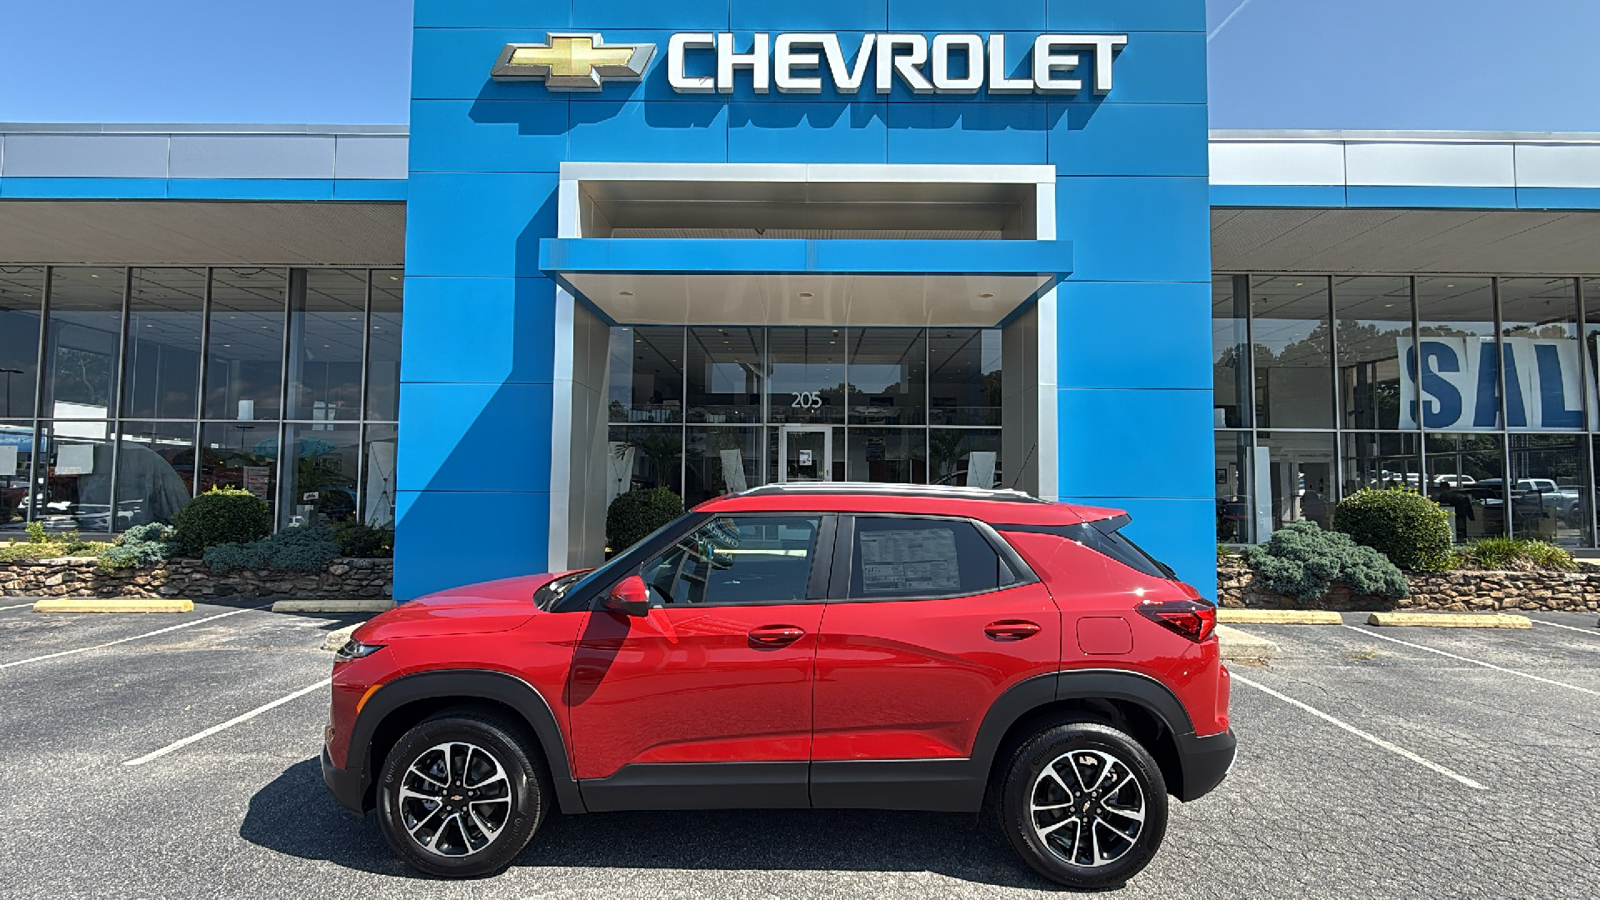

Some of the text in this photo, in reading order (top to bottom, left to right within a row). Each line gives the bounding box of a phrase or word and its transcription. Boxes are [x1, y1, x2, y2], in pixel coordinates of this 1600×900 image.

[667, 32, 1129, 94] CHEVROLET
[791, 391, 823, 408] 205
[1406, 341, 1600, 428] SAL
